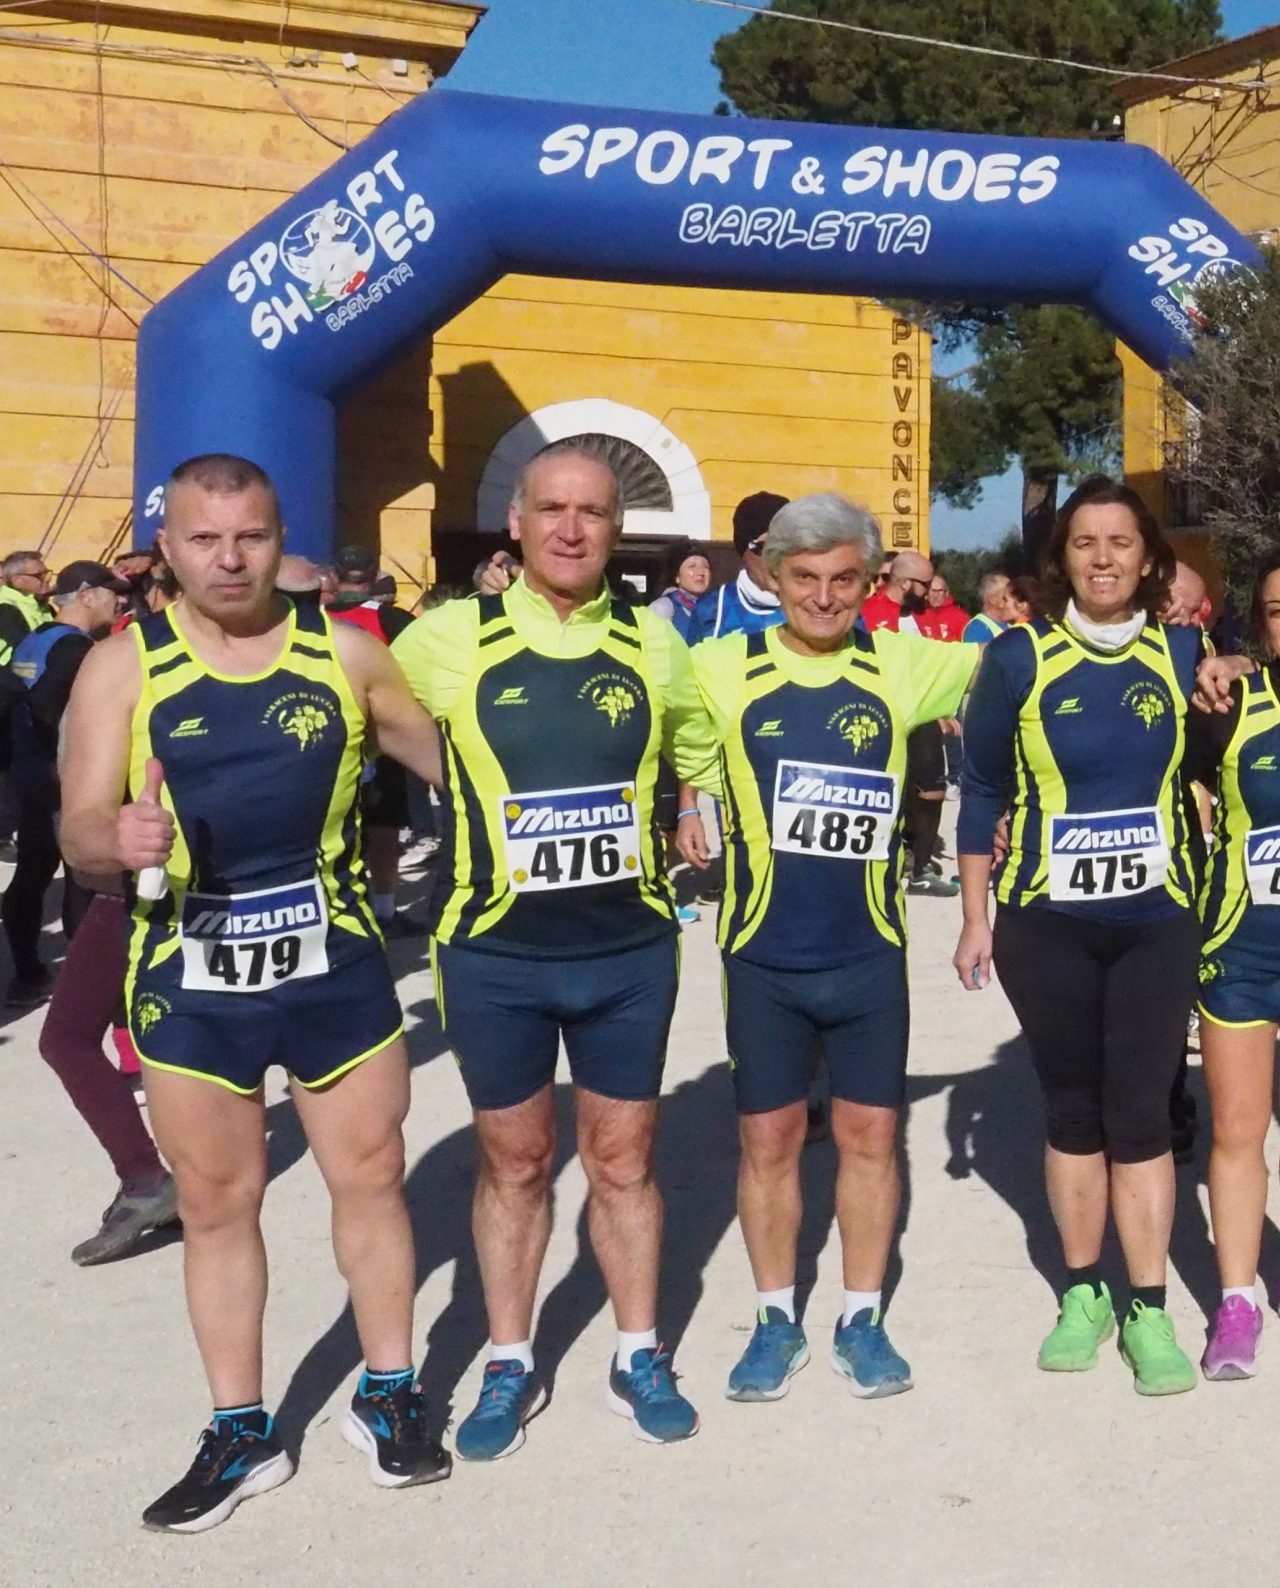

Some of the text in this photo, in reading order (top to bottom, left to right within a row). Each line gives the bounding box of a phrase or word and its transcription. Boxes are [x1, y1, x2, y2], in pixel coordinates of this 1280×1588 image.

[539, 124, 1060, 204] SPORT & SHOES
[679, 203, 932, 254] BARLETTA
[325, 262, 415, 332] BARLETTA
[788, 808, 877, 854] 483
[531, 834, 620, 883] 476
[1069, 853, 1147, 894] 475
[209, 936, 302, 986] 479
